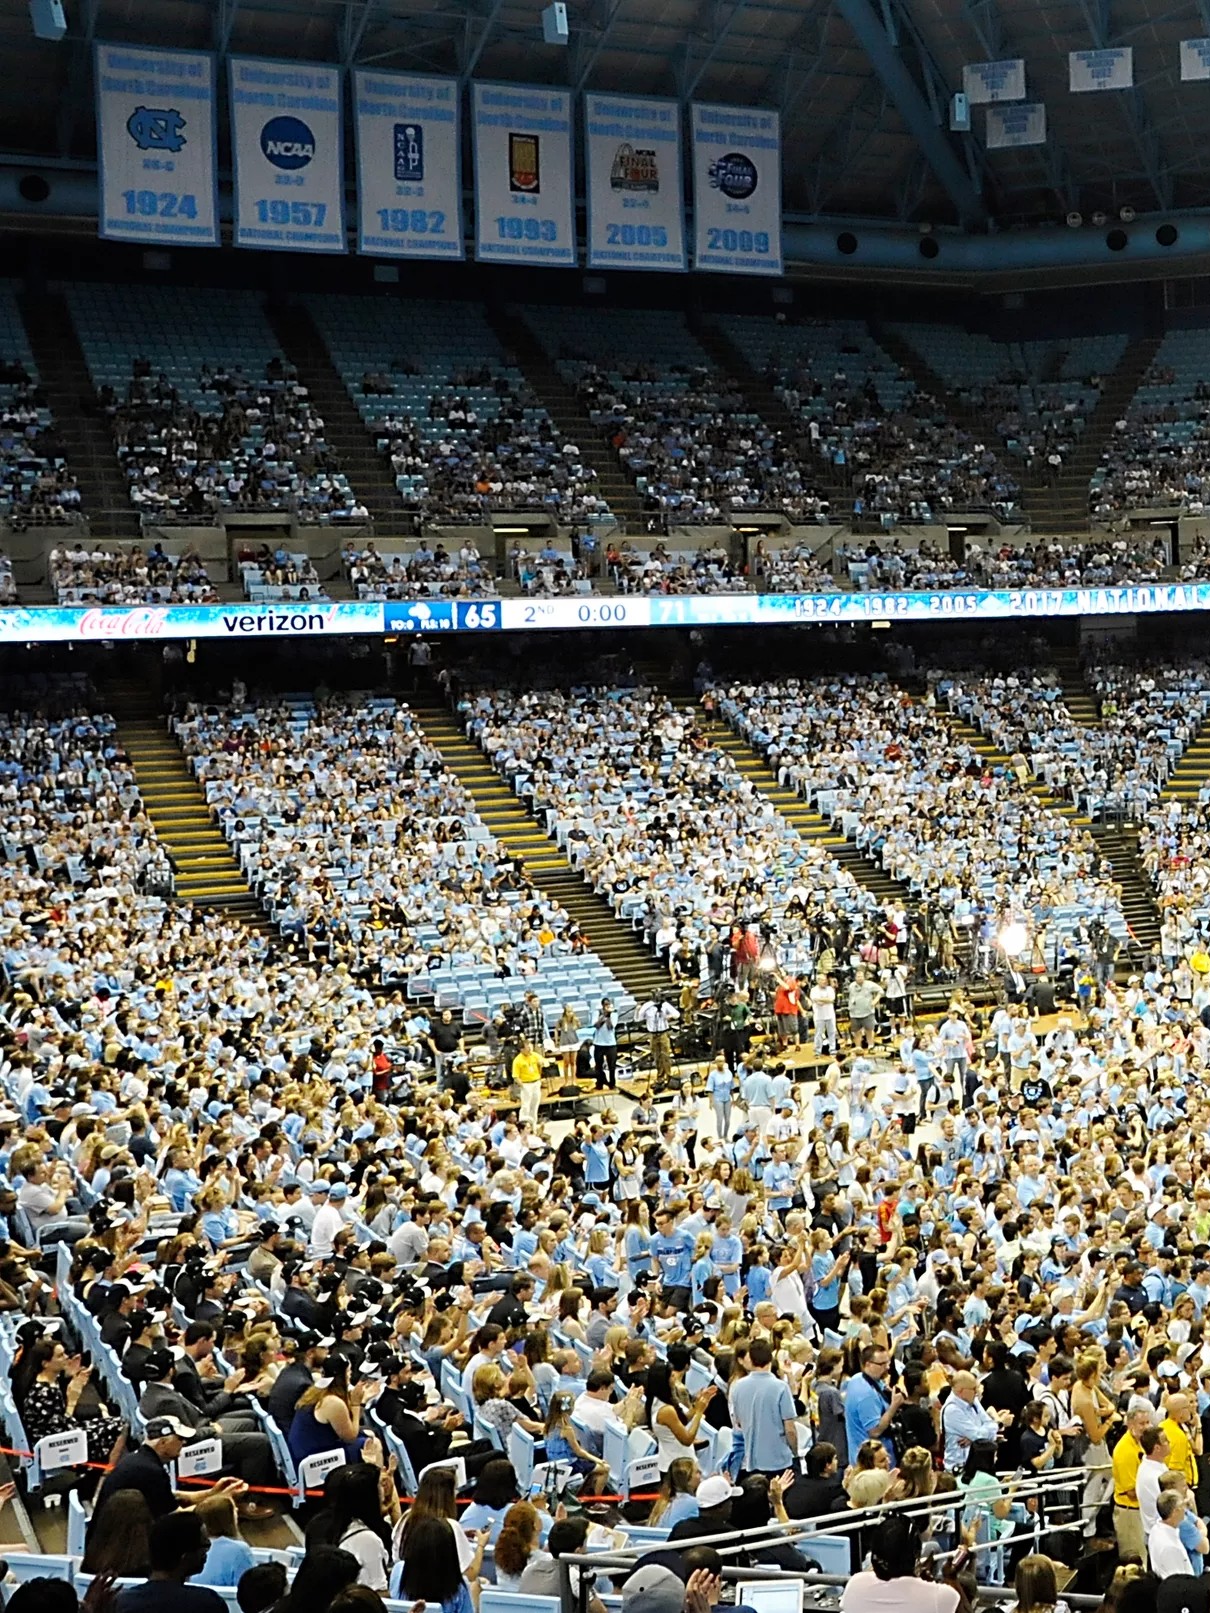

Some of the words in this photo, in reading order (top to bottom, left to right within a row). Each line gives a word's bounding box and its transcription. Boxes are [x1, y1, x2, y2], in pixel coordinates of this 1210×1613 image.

[266, 140, 314, 158] NCAA
[620, 156, 656, 169] FINAL
[624, 168, 658, 180] FOUR
[121, 190, 198, 219] 1924
[255, 199, 327, 227] 1957
[377, 208, 446, 234] 1982
[495, 216, 557, 242] 1993
[606, 223, 668, 247] 2005
[707, 227, 770, 254] 2009
[578, 604, 627, 622] 0:00
[658, 600, 686, 622] 71
[794, 597, 843, 617] 1924
[864, 596, 909, 615] 1982
[929, 595, 977, 615] 2005
[1009, 591, 1063, 615] 2017
[1078, 586, 1204, 614] NATIONAL
[223, 609, 325, 632] verizon
[465, 604, 497, 629] 65
[49, 1437, 79, 1448] RESERVED
[185, 1446, 215, 1458] RESERVED
[310, 1455, 339, 1469] RESERVED
